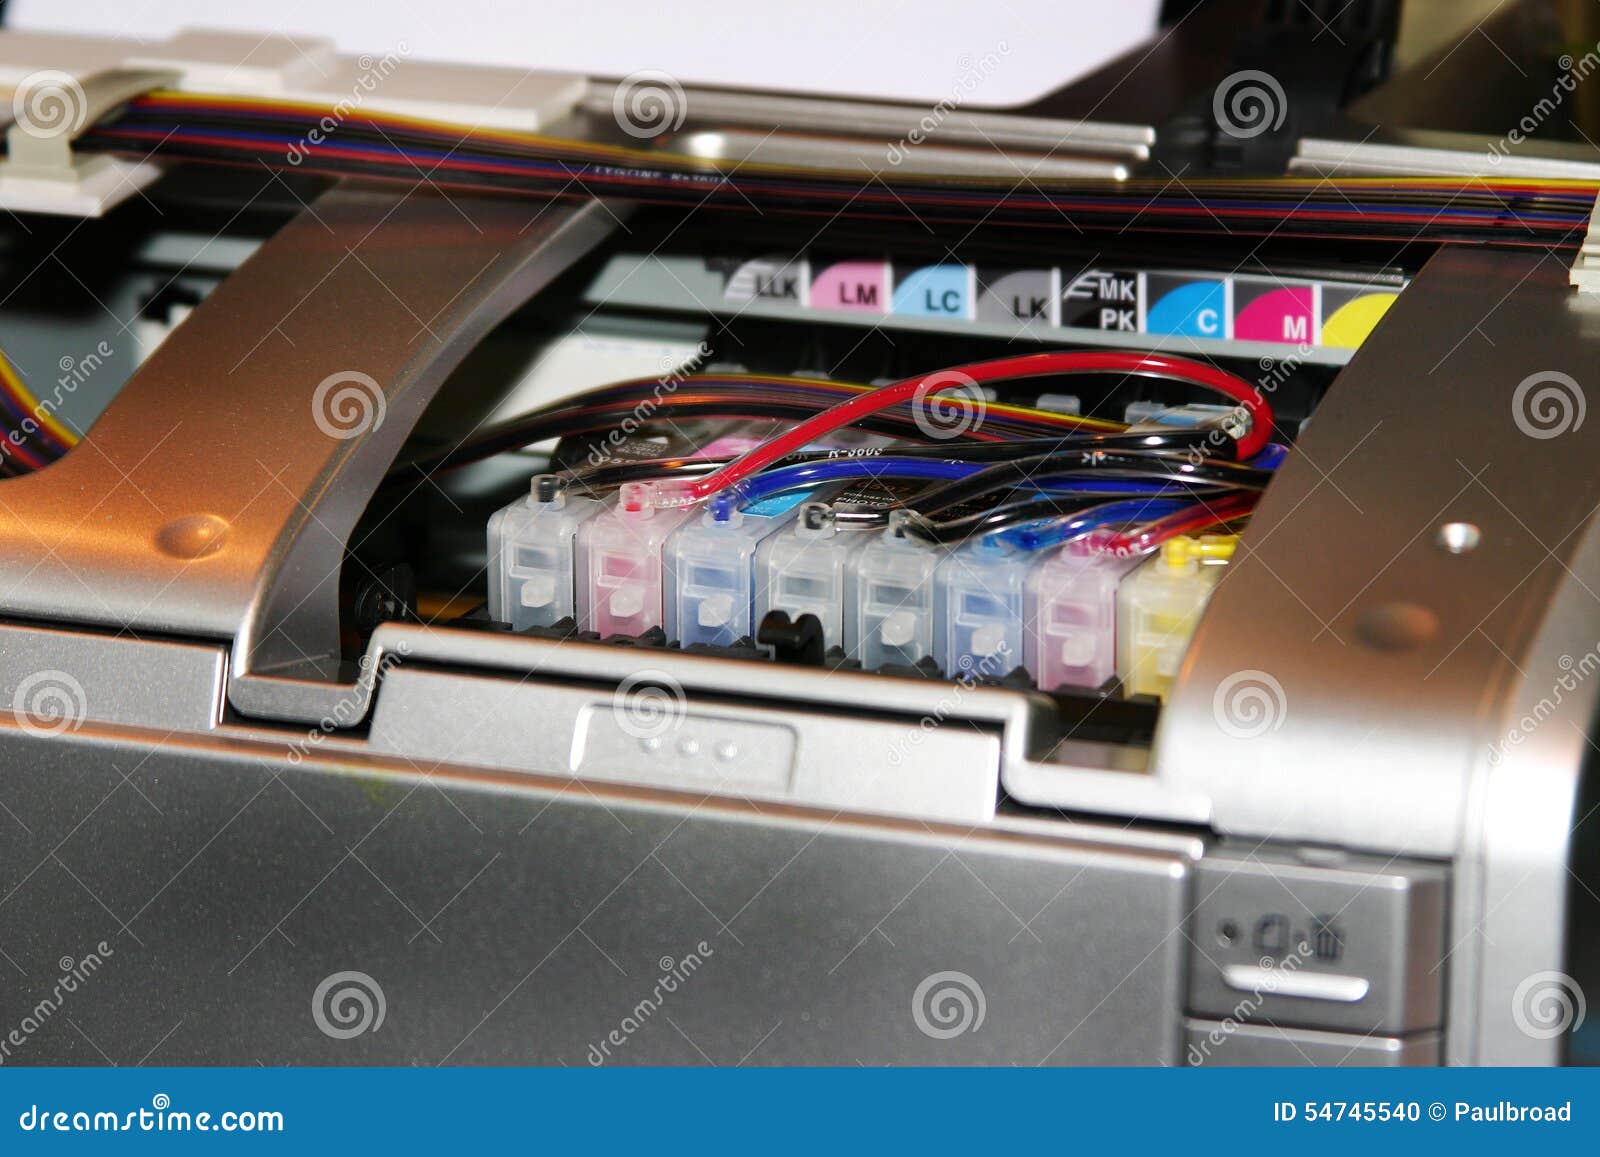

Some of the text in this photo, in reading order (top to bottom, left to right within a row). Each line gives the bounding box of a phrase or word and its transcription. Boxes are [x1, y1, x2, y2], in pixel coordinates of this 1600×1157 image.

[754, 272, 798, 299] LLK
[839, 281, 878, 306] LM
[1099, 278, 1136, 301] MK
[925, 288, 961, 313] LC
[1013, 295, 1048, 320] LK
[1100, 307, 1136, 331] PK
[1197, 308, 1218, 334] C
[1283, 315, 1307, 340] M
